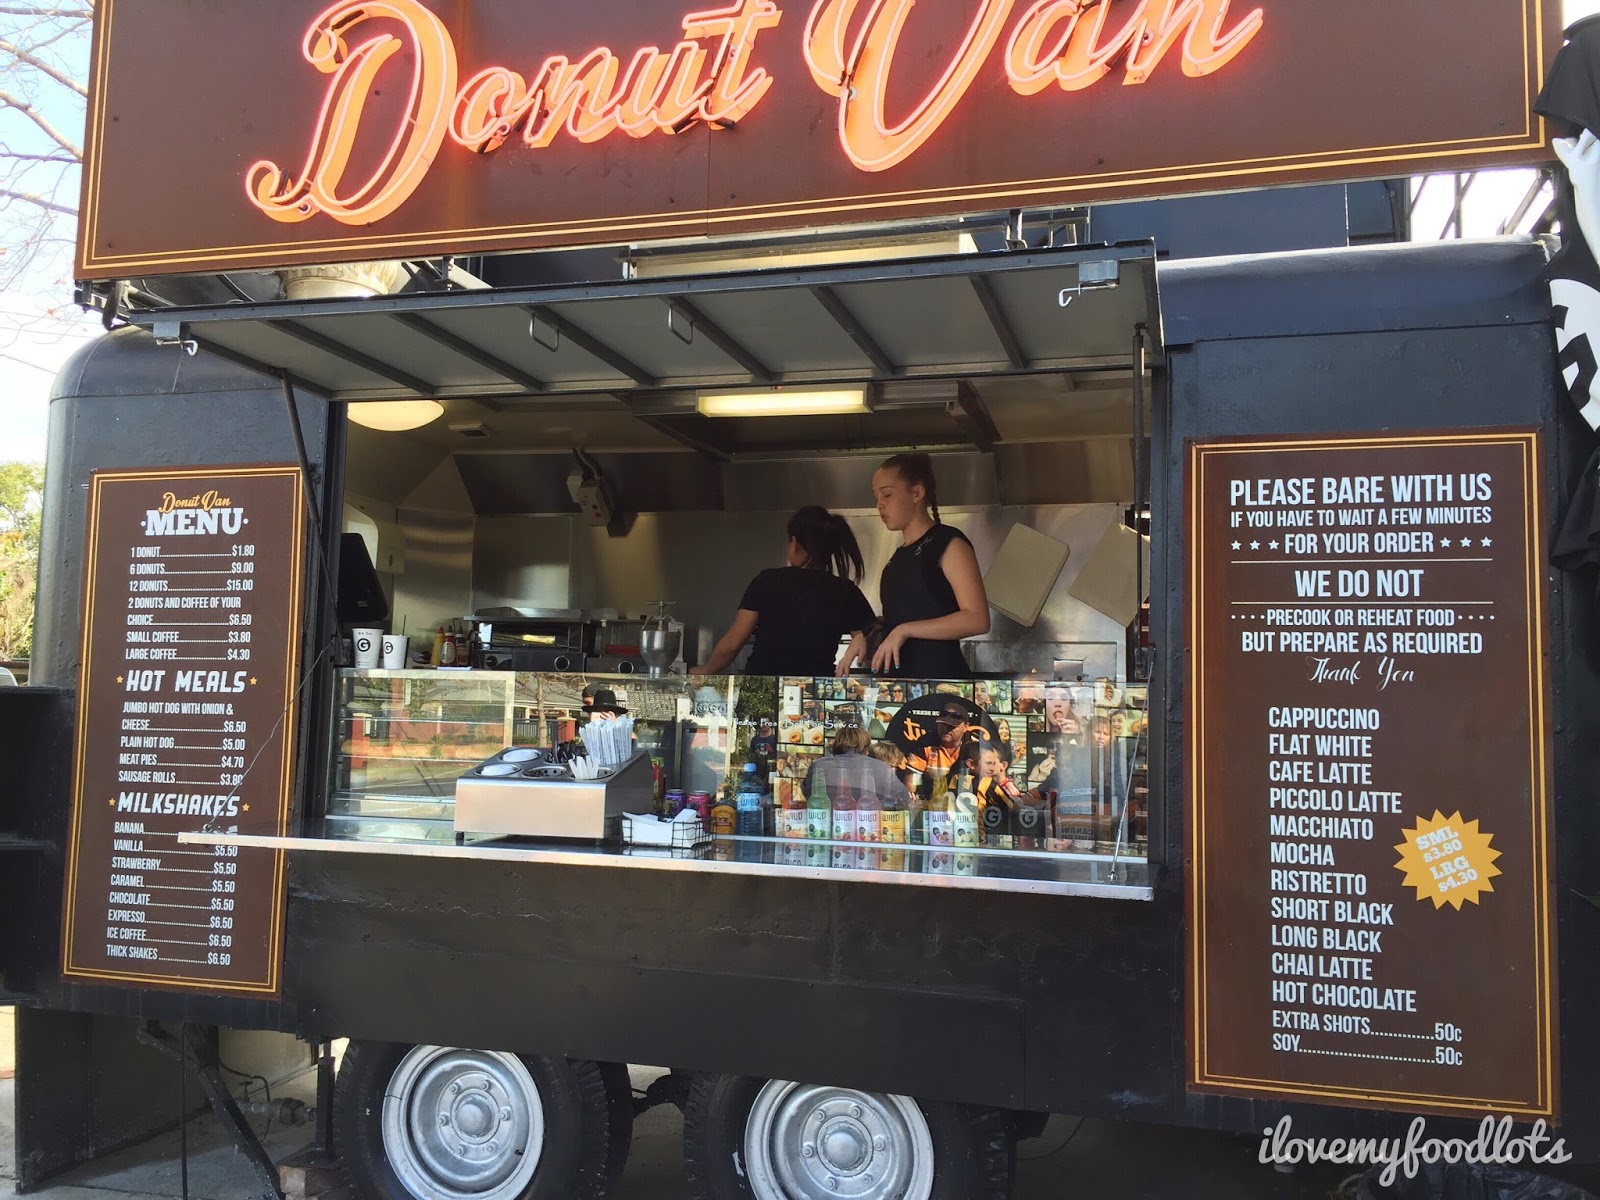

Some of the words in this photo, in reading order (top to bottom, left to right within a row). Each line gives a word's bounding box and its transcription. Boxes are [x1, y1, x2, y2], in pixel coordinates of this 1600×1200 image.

[245, 0, 784, 227] Donut
[804, 0, 1265, 173] Van
[1230, 479, 1315, 506] PLEASE
[1322, 476, 1384, 504] BARE
[1391, 474, 1452, 502] WITH
[1461, 473, 1492, 501] US
[158, 491, 200, 513] Donut
[200, 490, 232, 511] Van
[145, 507, 244, 536] MENU
[1231, 512, 1243, 527] IF
[1246, 511, 1273, 527] YOU
[1277, 510, 1313, 526] HAVE
[1318, 510, 1334, 526] TO
[1339, 509, 1375, 526] WAIT
[1378, 508, 1387, 525] A
[1391, 508, 1422, 525] FEW
[1426, 506, 1492, 524] MINUTES
[131, 547, 135, 558] 1
[137, 546, 161, 558] DONUT
[232, 545, 254, 556] $1.80
[1284, 534, 1318, 554] FOR
[1322, 533, 1369, 553] YOUR
[1374, 532, 1433, 552] ORDER
[130, 564, 135, 575] 6
[137, 563, 165, 575] DONUTS
[232, 562, 254, 574] $9.00
[129, 581, 138, 592] 12
[139, 580, 168, 592] DONUTS
[226, 580, 253, 591] $15.00
[1295, 570, 1330, 597] WE
[1338, 570, 1369, 597] DO
[1377, 569, 1424, 597] NOT
[128, 598, 134, 608] 2
[135, 598, 163, 608] DONUTS
[165, 598, 180, 608] AND
[181, 597, 209, 608] COFFEE
[210, 597, 220, 608] OF
[221, 597, 241, 608] YOUR
[127, 614, 153, 625] CHOICE
[229, 614, 252, 625] $6.50
[1266, 609, 1330, 626] PRECOOK
[1335, 609, 1354, 626] OR
[1358, 609, 1413, 626] REHEAT
[1417, 609, 1454, 626] FOOD
[127, 632, 150, 642] SMALL
[152, 632, 179, 642] COFFEE
[228, 631, 251, 643] $3.80
[1242, 632, 1275, 652] BUT
[1280, 632, 1359, 653] PREPARE
[1364, 632, 1387, 653] AS
[1393, 632, 1482, 654] REQUIRED
[126, 649, 149, 660] LARGE
[150, 649, 177, 660] COFFEE
[228, 649, 250, 661] $4.30
[1306, 656, 1361, 683] Thank
[126, 670, 165, 692] HOT
[175, 670, 247, 693] MEALS
[123, 702, 147, 713] JUMBO
[149, 703, 163, 713] HOT
[165, 703, 180, 714] DOG
[182, 703, 200, 714] WITH
[202, 703, 225, 714] ONION
[226, 704, 233, 715] &
[1269, 707, 1380, 730] CAPPUCCINO
[122, 719, 150, 730] CHEESE
[224, 720, 246, 732] $6.50
[824, 719, 858, 729] Servce
[121, 736, 142, 748] PLAIN
[144, 737, 158, 748] HOT
[160, 737, 174, 748] DOG
[223, 738, 245, 750] $5.00
[1270, 734, 1310, 756] FLAT
[1315, 735, 1372, 757] WHITE
[120, 753, 140, 765] MEAT
[141, 754, 157, 765] PIES
[222, 756, 244, 768] $4.70
[119, 770, 151, 783] SAUSAGE
[153, 772, 176, 783] ROLLS
[1269, 761, 1313, 783] CAFE
[1318, 762, 1372, 785] LATTE
[118, 792, 240, 817] MILKSHAKES
[1270, 788, 1343, 812] PICCOLO
[1348, 790, 1402, 814] LATTE
[809, 812, 826, 820] WILD
[114, 822, 144, 834] BANANA
[1270, 815, 1374, 840] MACCHIATO
[1416, 826, 1459, 850] SML
[114, 839, 144, 852] VANILLA
[215, 845, 237, 857] $5.50
[1270, 842, 1335, 866] MOCHA
[1423, 839, 1463, 863] $3.80
[112, 857, 161, 870] STRAWBERRY
[213, 862, 236, 875] $5.50
[1429, 855, 1469, 880] LRG
[111, 874, 145, 888] CARAMEL
[212, 881, 235, 893] $5.50
[1271, 869, 1367, 896] RISTRETTO
[1438, 868, 1478, 893] $4.30
[109, 892, 150, 906] CHOCOLATE
[211, 898, 234, 911] $5.50
[1271, 897, 1329, 922] SHORT
[1335, 902, 1394, 926] BLACK
[108, 910, 145, 923] EXPRESSO
[210, 916, 232, 929] $6.50
[107, 927, 118, 939] ICE
[120, 928, 146, 940] COFFEE
[208, 934, 231, 947] $6.50
[1272, 925, 1317, 949] LONG
[1323, 928, 1382, 952] BLACK
[107, 945, 127, 957] THICK
[129, 946, 157, 959] SHAKES
[208, 952, 230, 965] $6.50
[1272, 952, 1314, 976] CHAI
[1319, 956, 1373, 980] LATTE
[1272, 980, 1308, 1004] HOT
[1312, 983, 1417, 1012] CHOCOLATE
[1272, 1010, 1320, 1031] EXTRA
[1323, 1014, 1370, 1035] SHOTS
[1273, 1033, 1300, 1052] SOY
